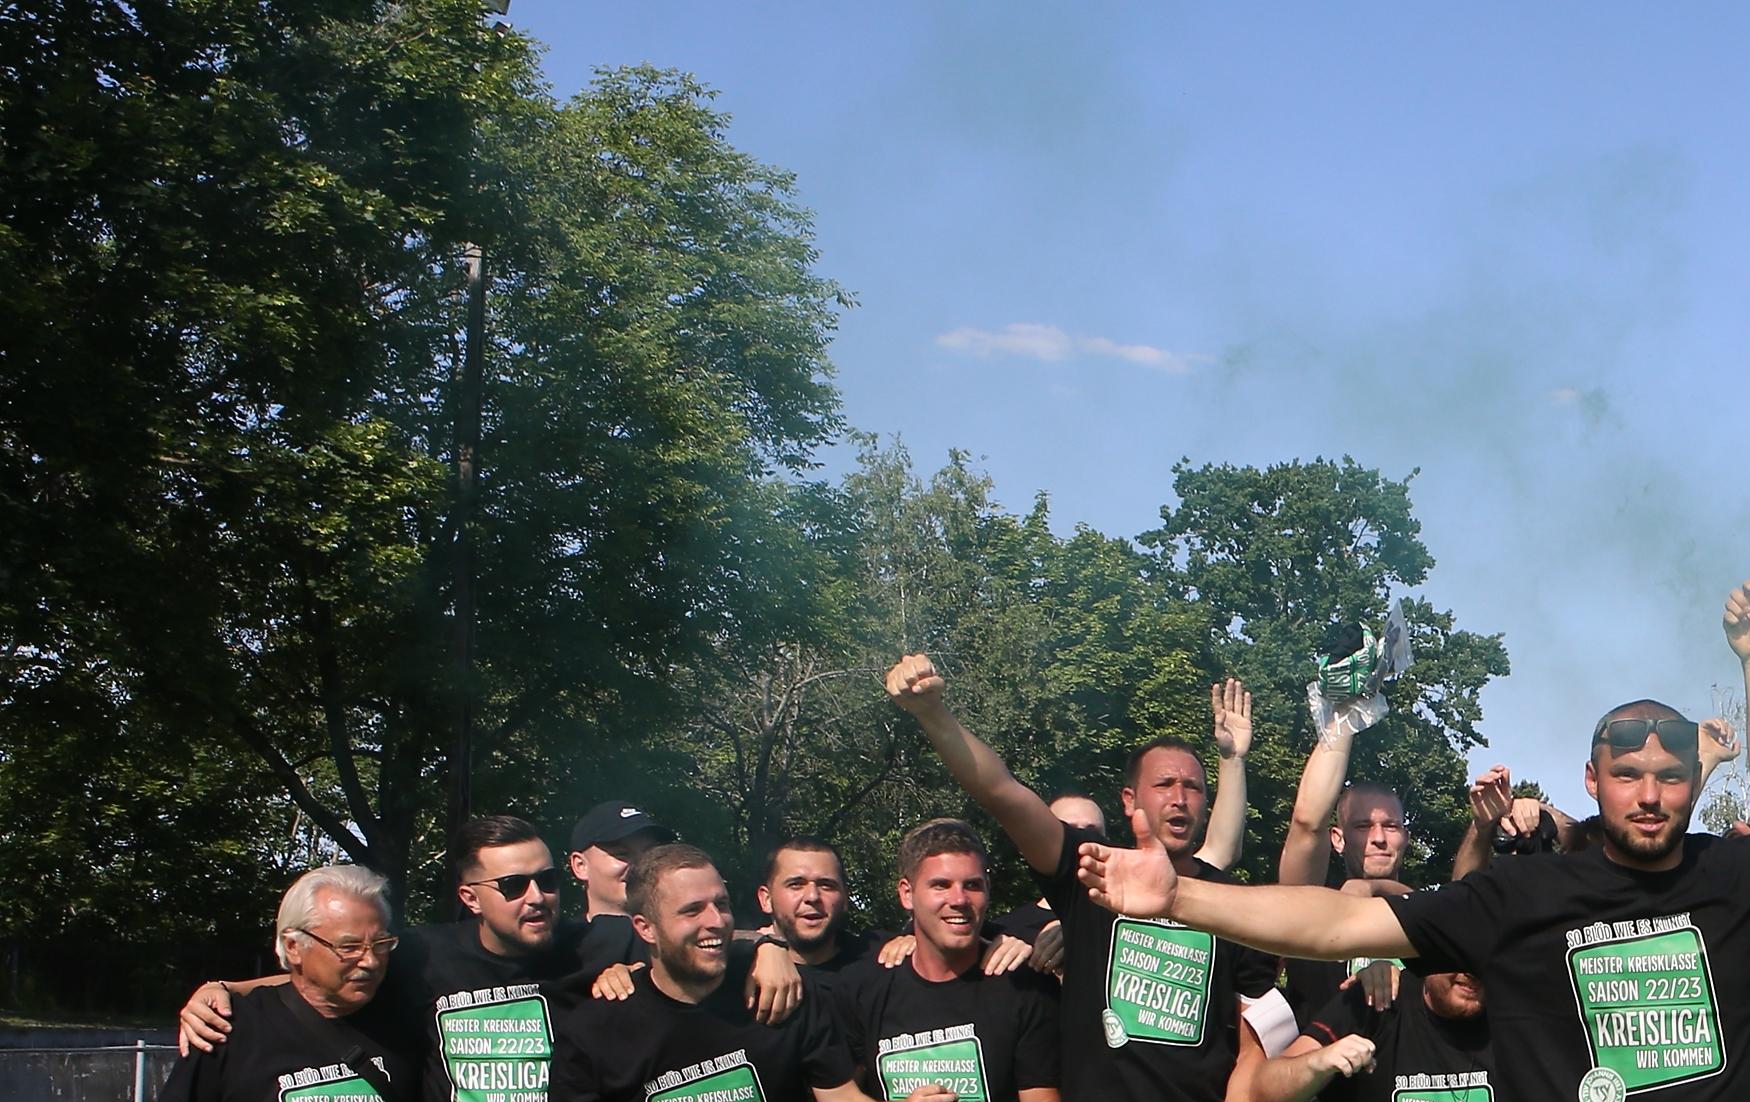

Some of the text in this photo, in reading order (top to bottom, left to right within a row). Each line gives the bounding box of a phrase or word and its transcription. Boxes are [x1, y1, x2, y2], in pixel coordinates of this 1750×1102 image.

[1566, 912, 1691, 948] SO BLÖD WIE ES KLINGT
[1120, 928, 1208, 964] MEISTER KREISKLASSE
[1120, 947, 1204, 985] SAISON 22/23
[1580, 953, 1697, 974] MEISTER KREISKLASSE
[1114, 971, 1201, 1021] KREISLIGA
[1588, 977, 1701, 1003] SAISON 22/23
[445, 1019, 542, 1033] MEISTER KREISKLASSE
[1138, 1009, 1196, 1038] WIR KOMMEN
[1596, 1008, 1711, 1047] KREISLIGA
[450, 1038, 545, 1055] SAISON 22/23
[1636, 1047, 1712, 1068] WIR KOMMEN
[278, 1075, 293, 1088] SO
[294, 1067, 320, 1086] BLÖD
[321, 1064, 340, 1080] WIE
[456, 1061, 549, 1090] KREISLIGA
[682, 1064, 701, 1080] WIE
[886, 1059, 975, 1073] MEISTER KREISKLASSE
